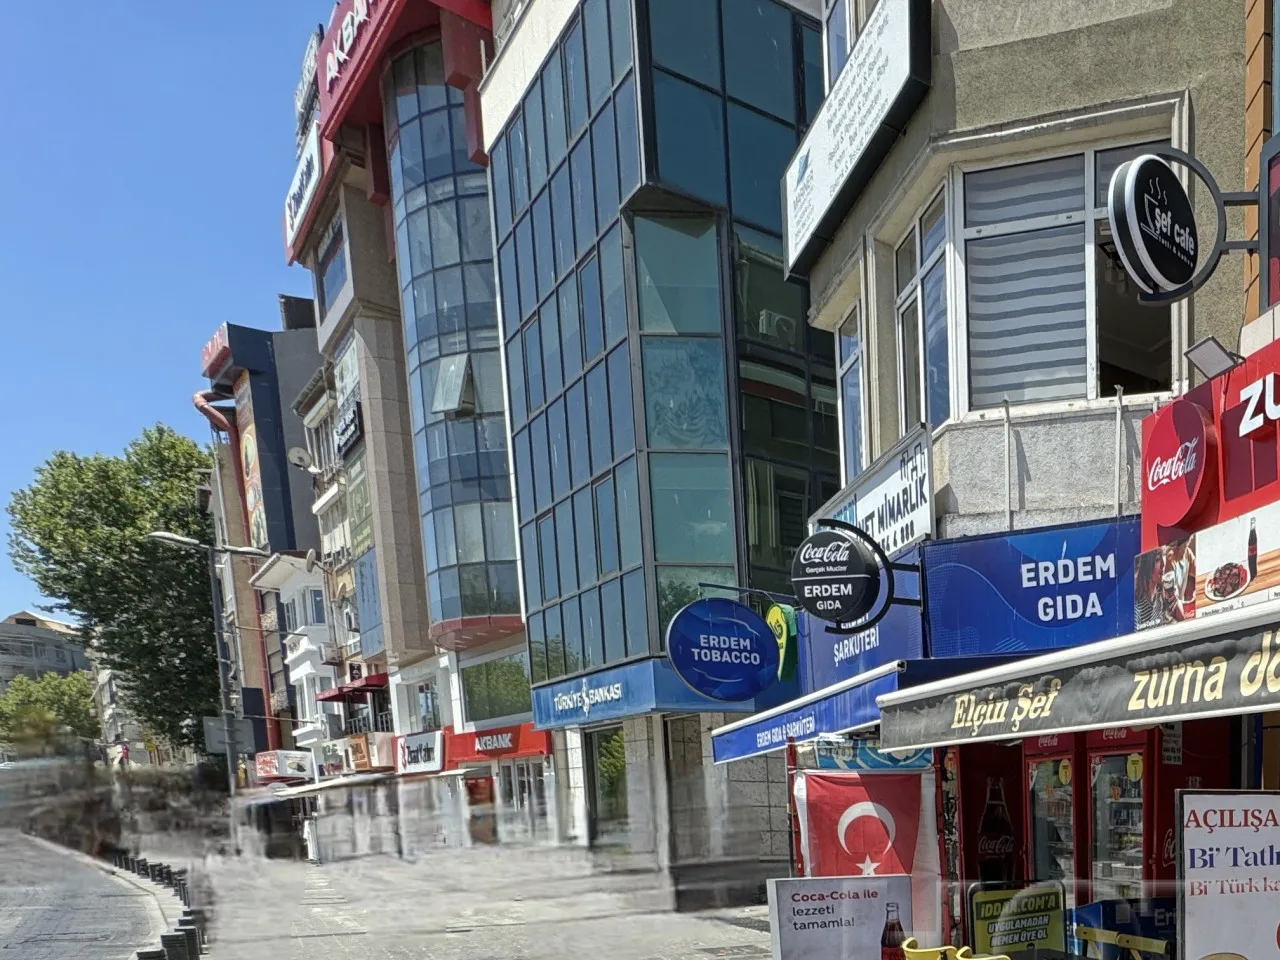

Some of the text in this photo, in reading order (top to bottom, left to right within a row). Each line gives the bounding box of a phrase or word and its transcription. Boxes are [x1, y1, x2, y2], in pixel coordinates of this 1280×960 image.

[326, 0, 374, 93] AKBA
[1174, 223, 1195, 256] cafe
[1147, 436, 1199, 491] Coca-Cola
[877, 473, 927, 534] MİMARLIK
[800, 541, 851, 564] Coca-Cola
[1021, 553, 1115, 588] ERDEM
[804, 583, 852, 598] ERDEM
[816, 600, 842, 610] GIDA
[1037, 592, 1103, 622] GIDA
[700, 634, 750, 651] ERDEM
[691, 648, 760, 666] TOBACCO
[1128, 655, 1229, 710] zurna
[553, 682, 623, 712] TÜRKİYE BANKASI
[951, 677, 1061, 736] Elçin Şef
[475, 732, 513, 752] AKBANK
[1184, 808, 1280, 834] AÇILIŞA
[1225, 844, 1280, 868] Tatlı
[791, 889, 879, 903] Coca-Cola ile
[1214, 877, 1259, 894] Türk
[792, 904, 835, 917] lezzeti
[793, 917, 855, 931] tamamla!
[1037, 928, 1048, 939] OL
